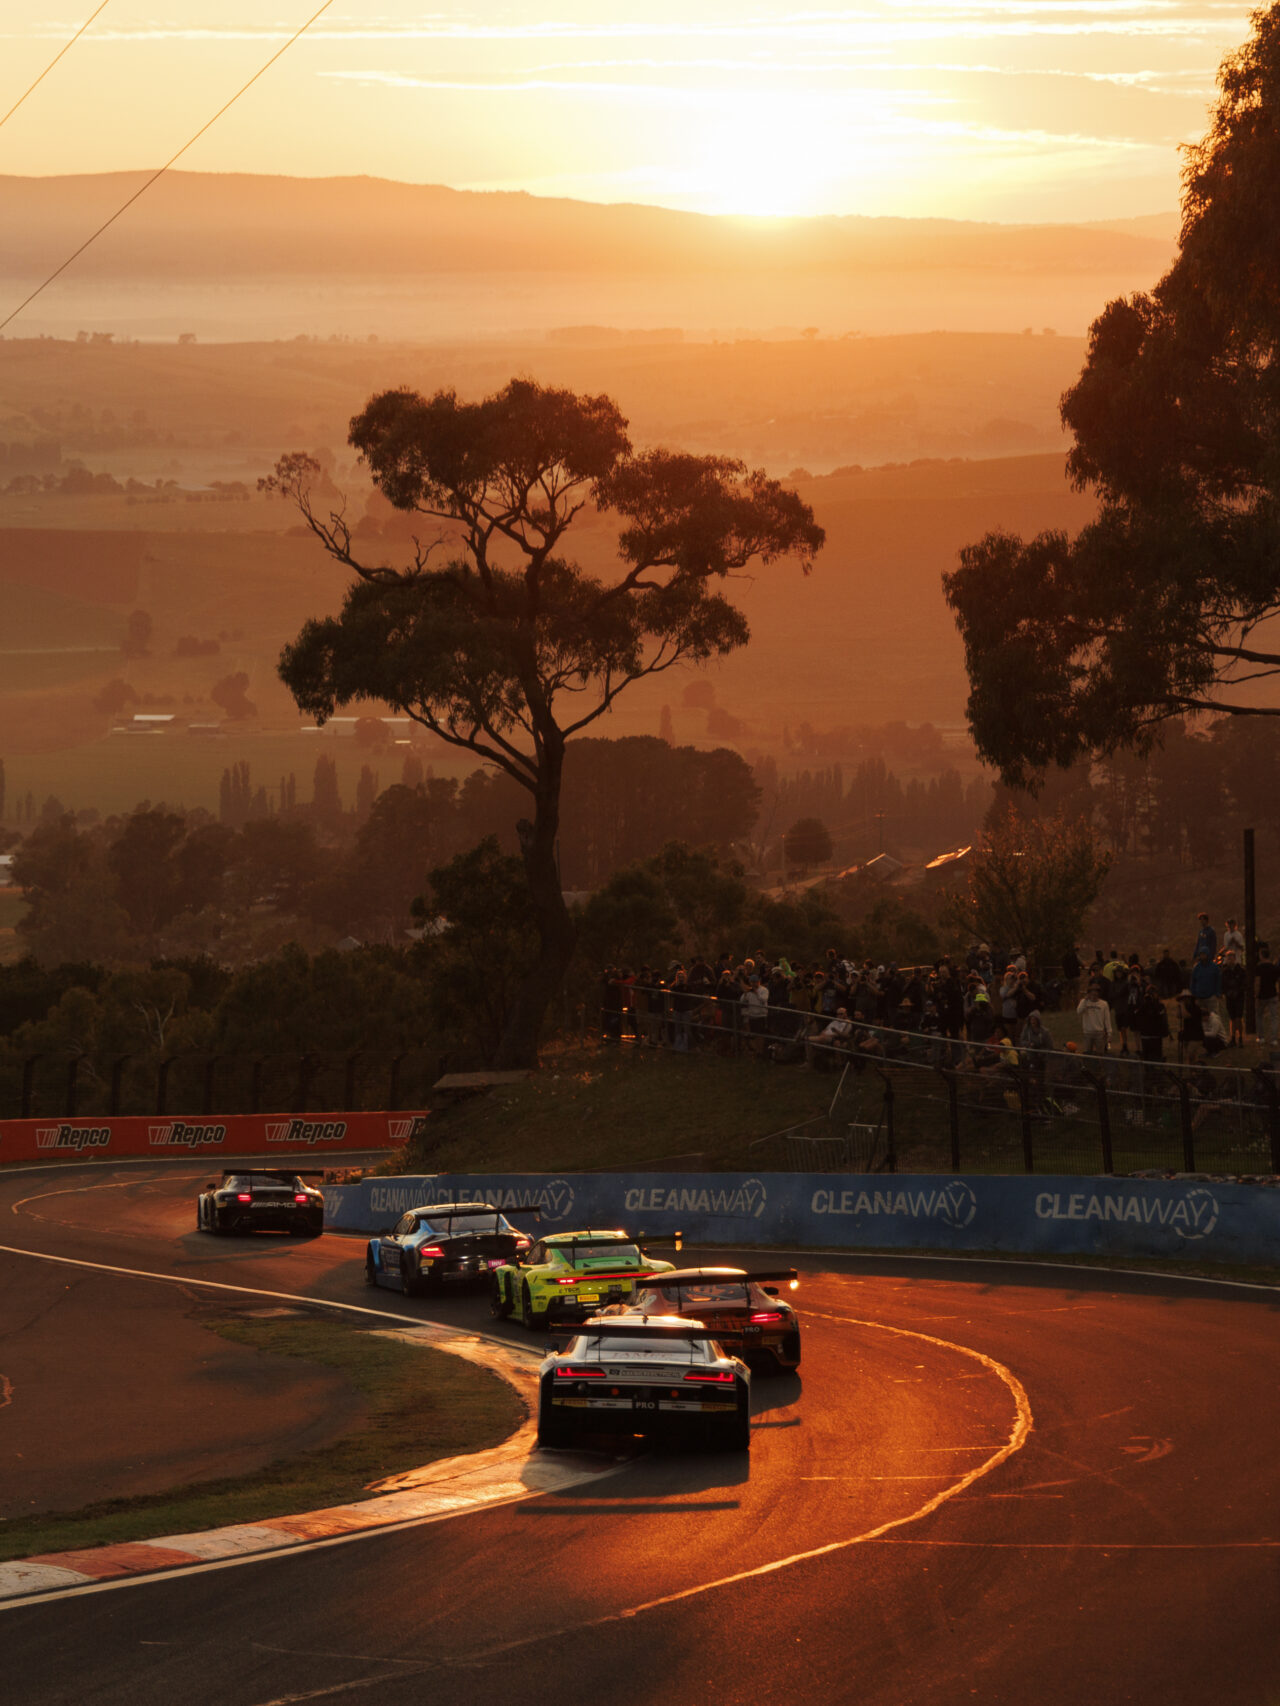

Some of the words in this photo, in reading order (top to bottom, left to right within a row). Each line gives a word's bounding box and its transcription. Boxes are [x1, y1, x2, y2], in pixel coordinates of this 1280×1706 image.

[57, 1124, 110, 1150] Repco
[170, 1122, 226, 1147] Repco
[288, 1119, 347, 1144] Repco
[370, 1188, 432, 1212] CLEANAWAY
[625, 1188, 757, 1214] CLEANAWAY
[811, 1190, 965, 1219] CLEANAWAY
[1035, 1193, 1208, 1227] CLEANAWAY
[635, 1402, 655, 1410] PRO
